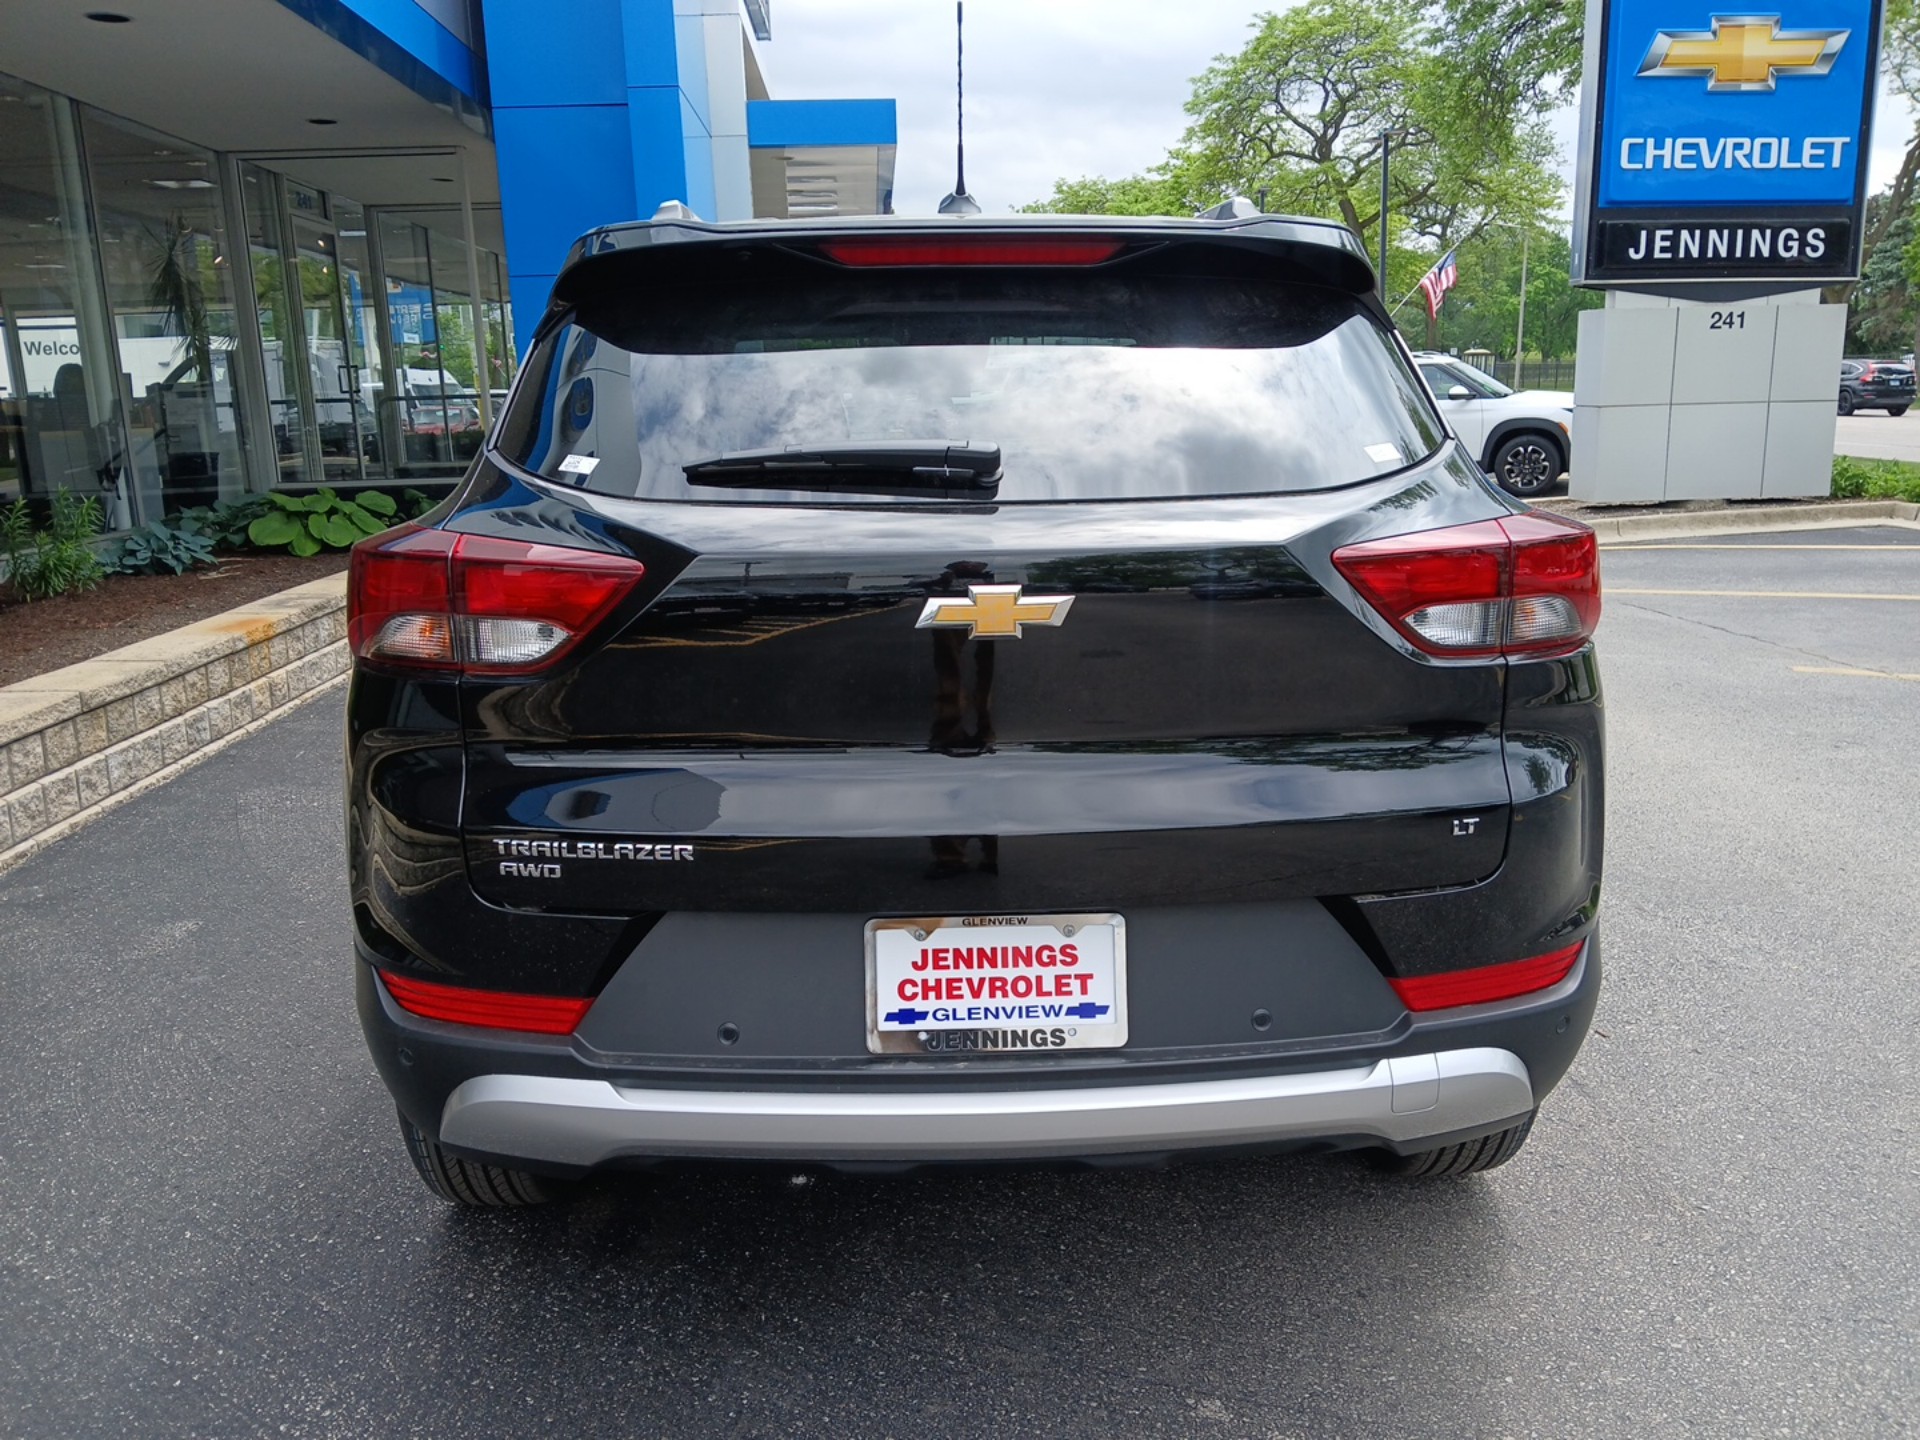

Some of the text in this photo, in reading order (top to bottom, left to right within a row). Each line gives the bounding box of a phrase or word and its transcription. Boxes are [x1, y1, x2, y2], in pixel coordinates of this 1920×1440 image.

[1620, 137, 1850, 169] CHEVROLET
[1628, 227, 1826, 260] JENNINGS
[1710, 311, 1746, 330] 241
[1453, 817, 1480, 836] LT
[493, 839, 694, 861] TRAILBLAZER
[499, 862, 562, 879] AWD
[962, 916, 1029, 927] GLENVIEW
[911, 943, 1079, 971] JENNINGS
[897, 973, 1094, 1002] CHEVROLET
[931, 1004, 1064, 1022] GLENVIEW
[926, 1028, 1067, 1050] JENNINGS
